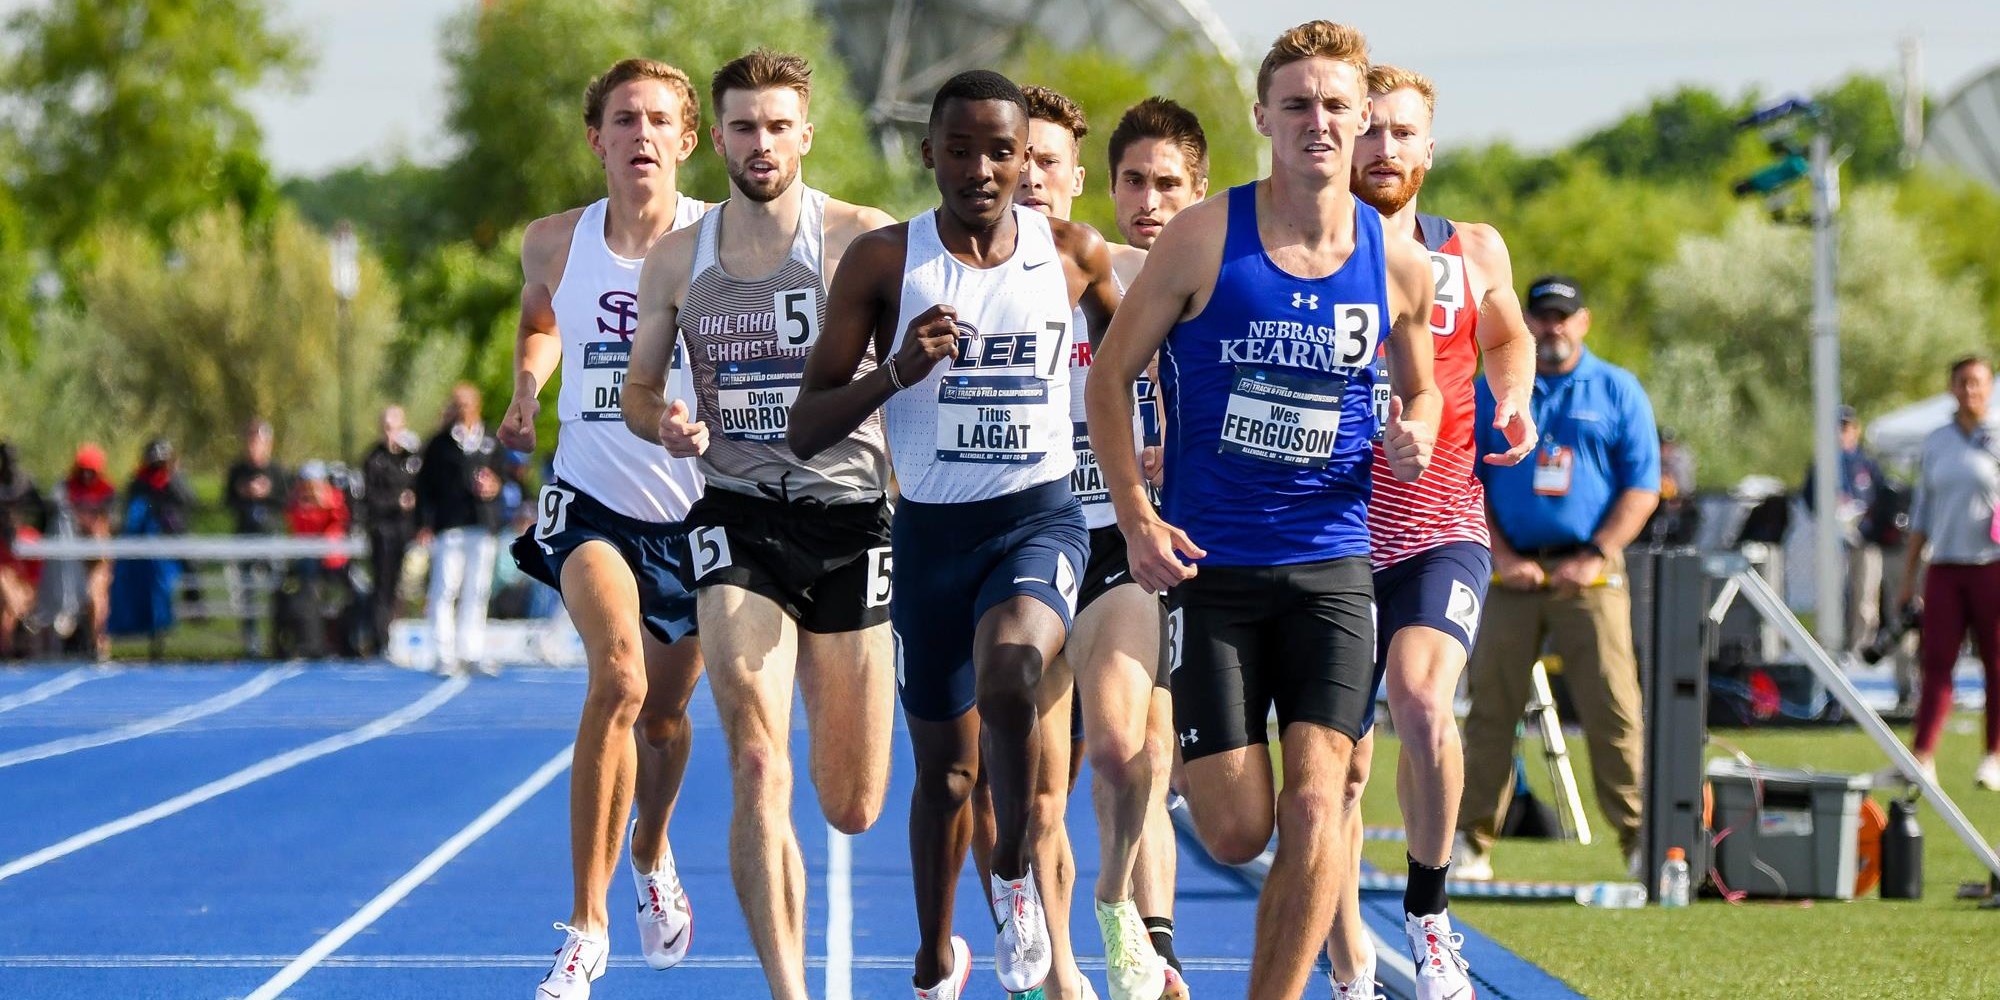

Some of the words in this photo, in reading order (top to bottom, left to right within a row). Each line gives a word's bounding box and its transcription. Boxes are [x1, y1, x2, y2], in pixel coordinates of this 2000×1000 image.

[1431, 255, 1454, 302] 2
[699, 312, 776, 335] OKLAHO
[785, 292, 810, 345] 5
[1247, 320, 1336, 347] NEBRASK
[1342, 307, 1369, 364] 3
[949, 331, 1037, 371] LEE
[1045, 321, 1066, 376] 7
[1218, 338, 1361, 377] KEARN
[748, 391, 784, 406] Dylan
[957, 389, 976, 397] TRACK
[981, 389, 998, 397] FIELD
[998, 388, 1044, 397] CHAMPIONSHIPS
[1252, 384, 1271, 394] TRACK
[1275, 389, 1292, 397] FIELD
[1292, 391, 1339, 403] CHAMPIONSHIPS
[977, 407, 1012, 422] Titus
[1223, 413, 1334, 454] FERGUSON
[1270, 404, 1301, 424] Wes
[957, 424, 1031, 449] LAGAT
[542, 490, 564, 535] 9
[697, 526, 721, 573] 5
[876, 551, 893, 602] 5
